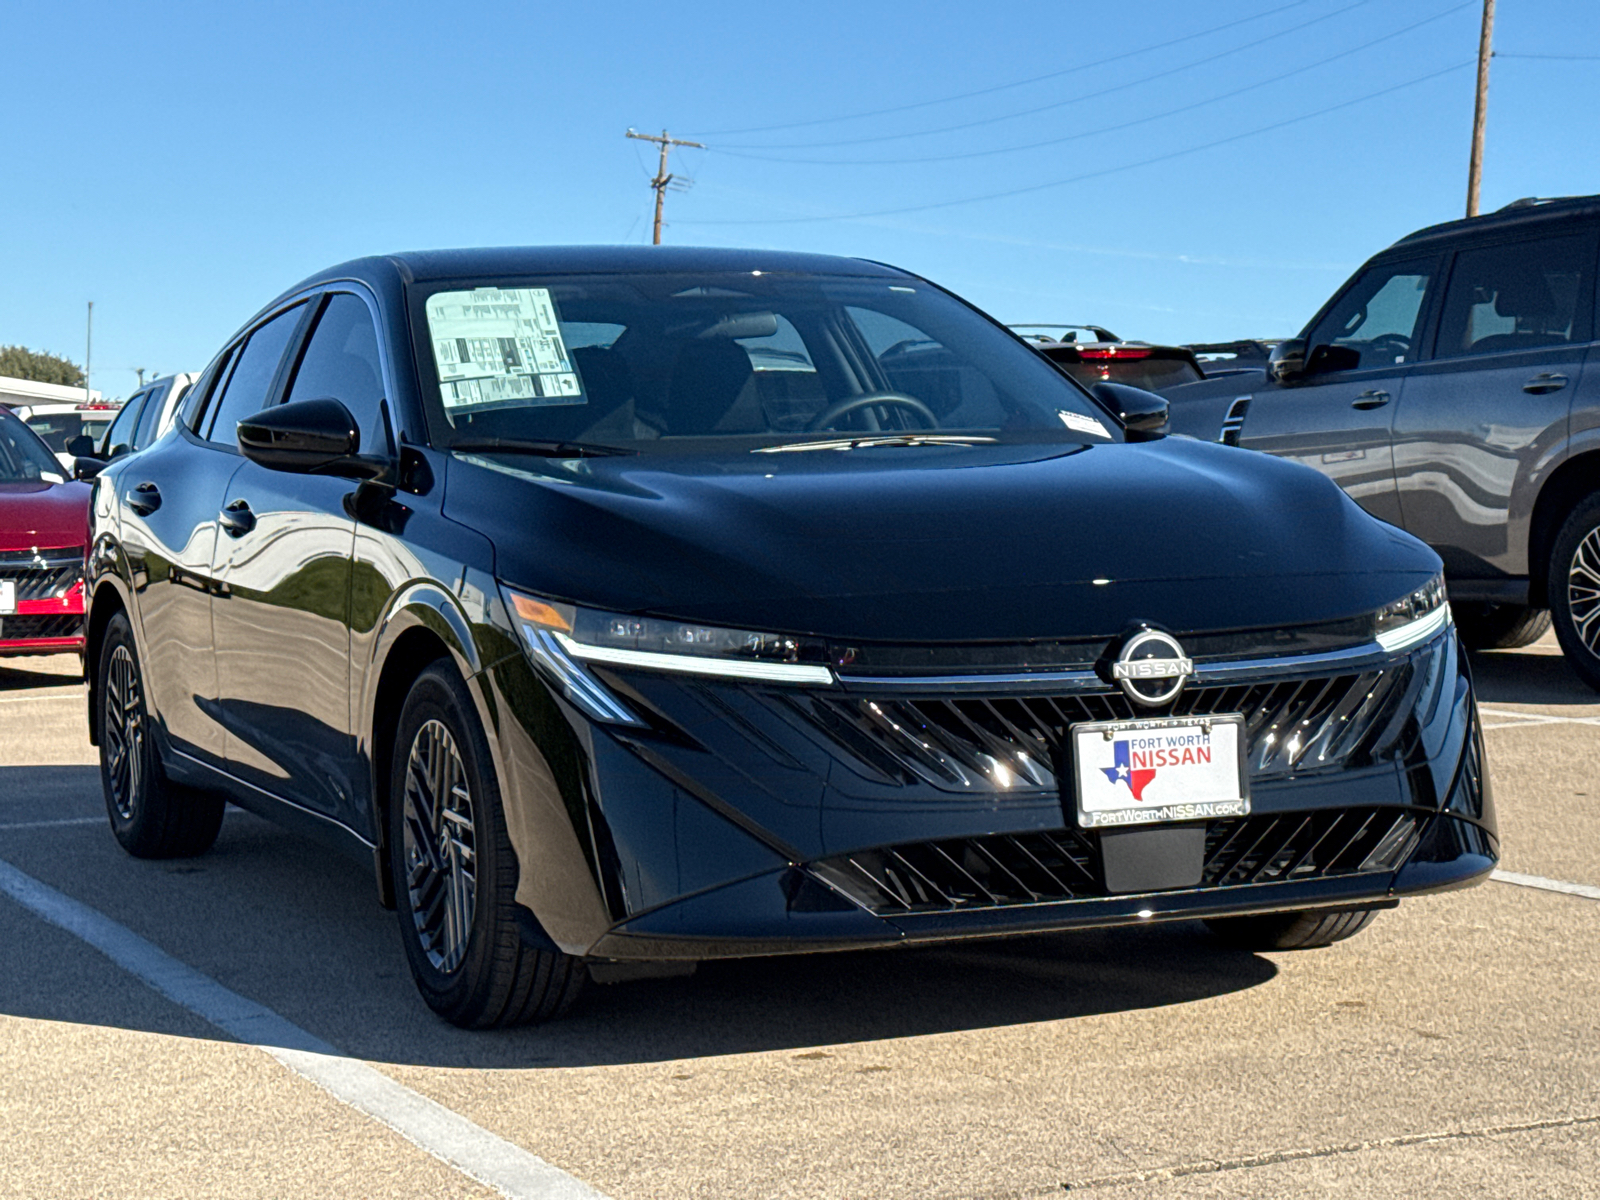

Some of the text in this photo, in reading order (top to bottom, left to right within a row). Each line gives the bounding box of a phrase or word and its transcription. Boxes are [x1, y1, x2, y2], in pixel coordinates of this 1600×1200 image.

[1114, 661, 1192, 677] NISSAN
[1107, 718, 1211, 731] FORT WORTH TEXAS
[1131, 735, 1211, 750] FORT WORTH
[1132, 747, 1211, 768] NISSAN
